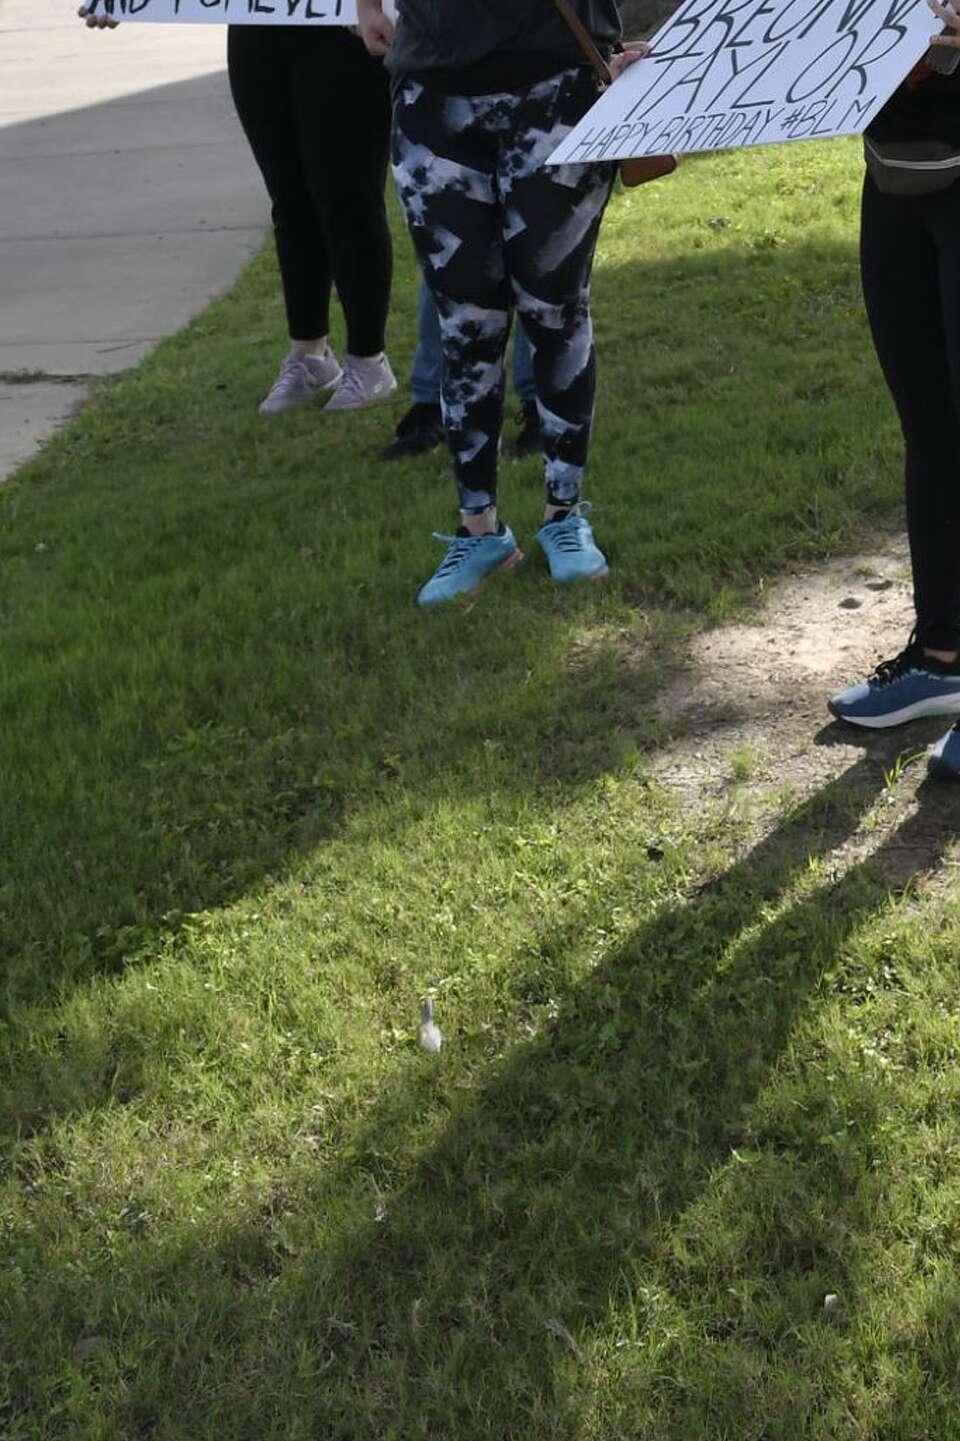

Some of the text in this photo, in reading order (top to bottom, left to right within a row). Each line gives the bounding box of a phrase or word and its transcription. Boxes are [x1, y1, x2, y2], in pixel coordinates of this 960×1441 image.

[623, 24, 908, 122] TAYLOR
[566, 96, 877, 161] HAPPY BIRTHDAY #BLM
